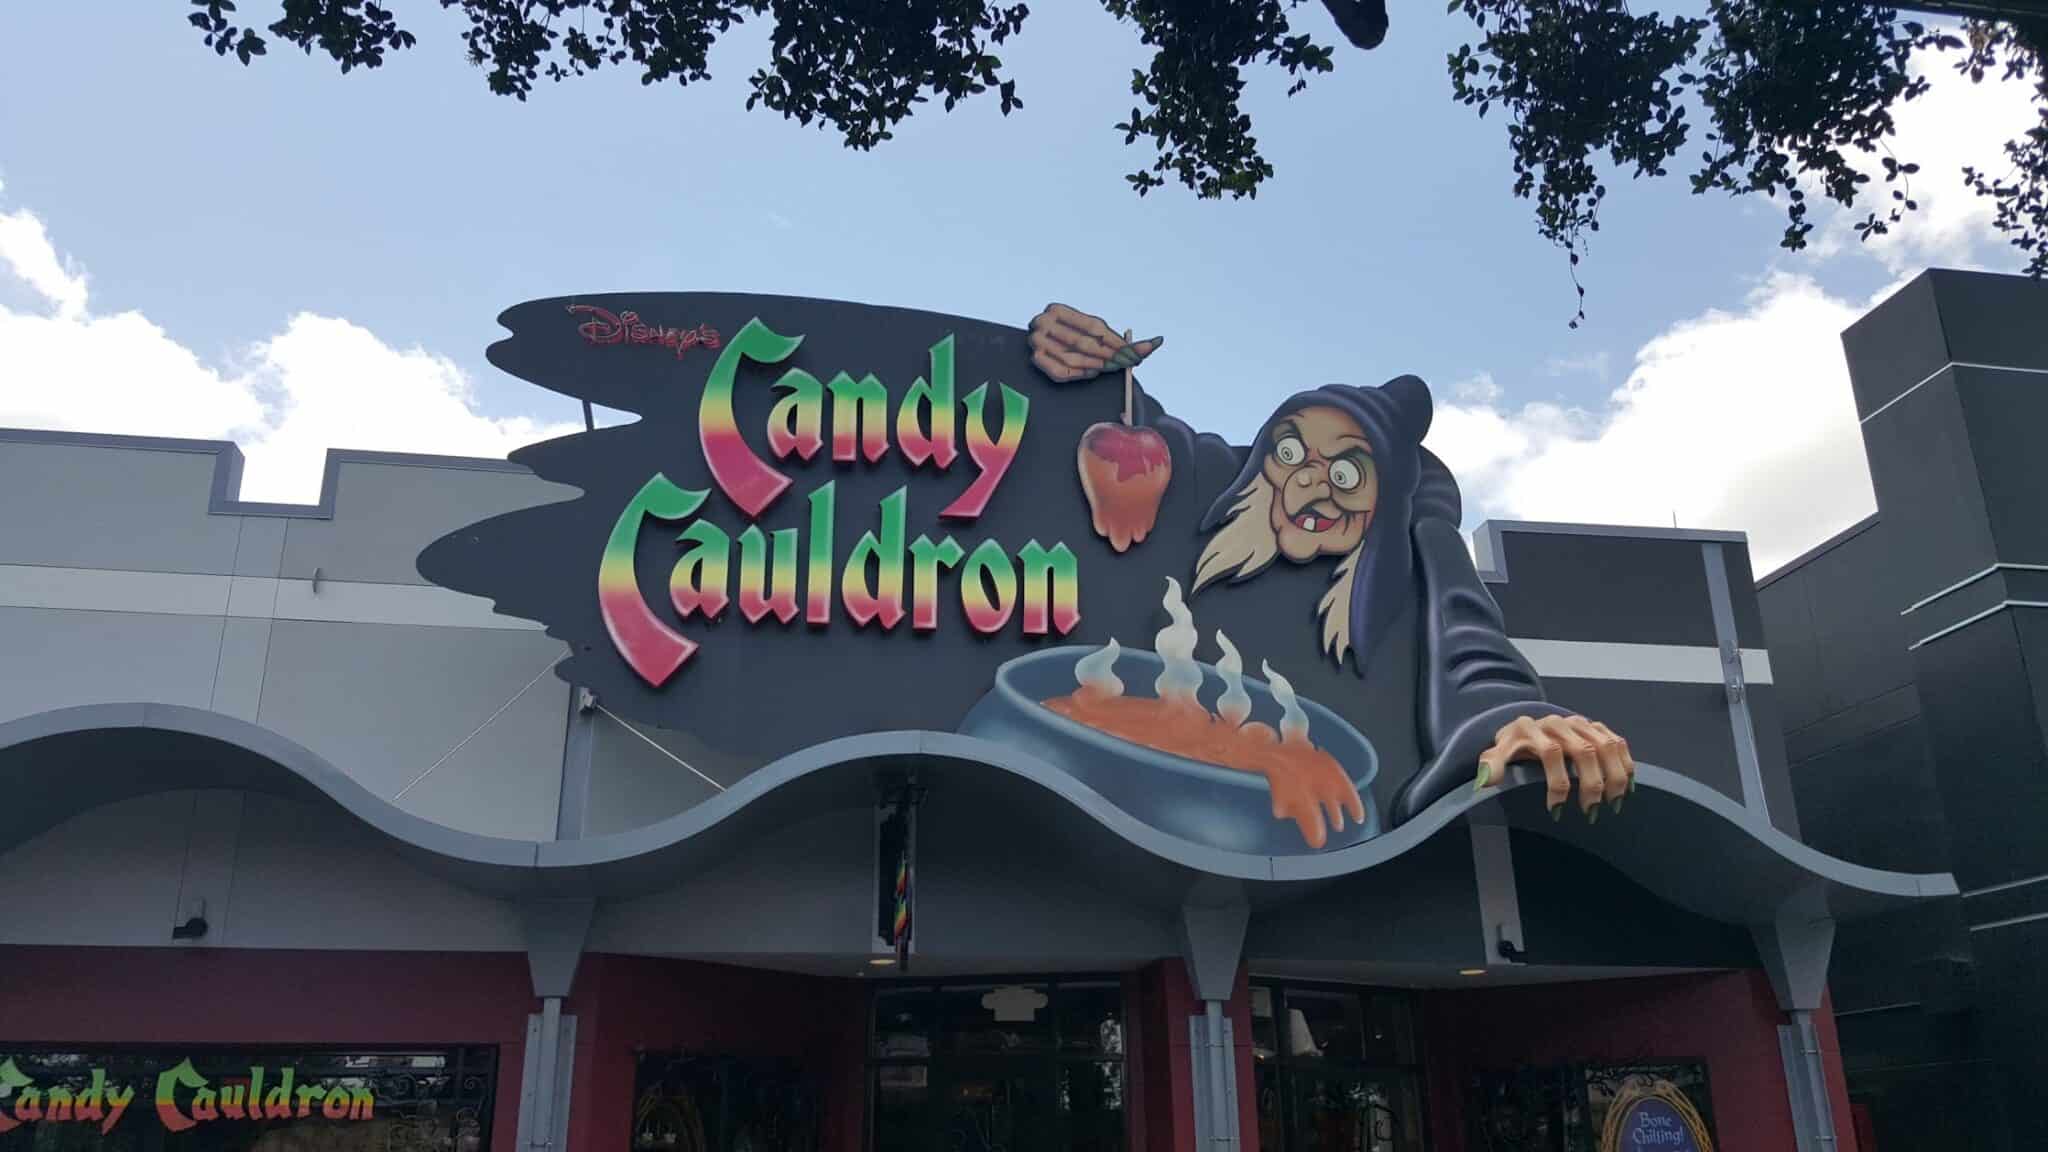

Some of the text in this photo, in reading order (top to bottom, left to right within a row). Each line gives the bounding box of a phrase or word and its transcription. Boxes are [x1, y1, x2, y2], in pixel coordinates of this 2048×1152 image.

[700, 317, 1029, 519] Candy
[599, 472, 1081, 687] Cauldron
[156, 1057, 374, 1132] Cauldron
[1639, 1111, 1673, 1127] Bone
[1632, 1126, 1684, 1145] Chilling!
